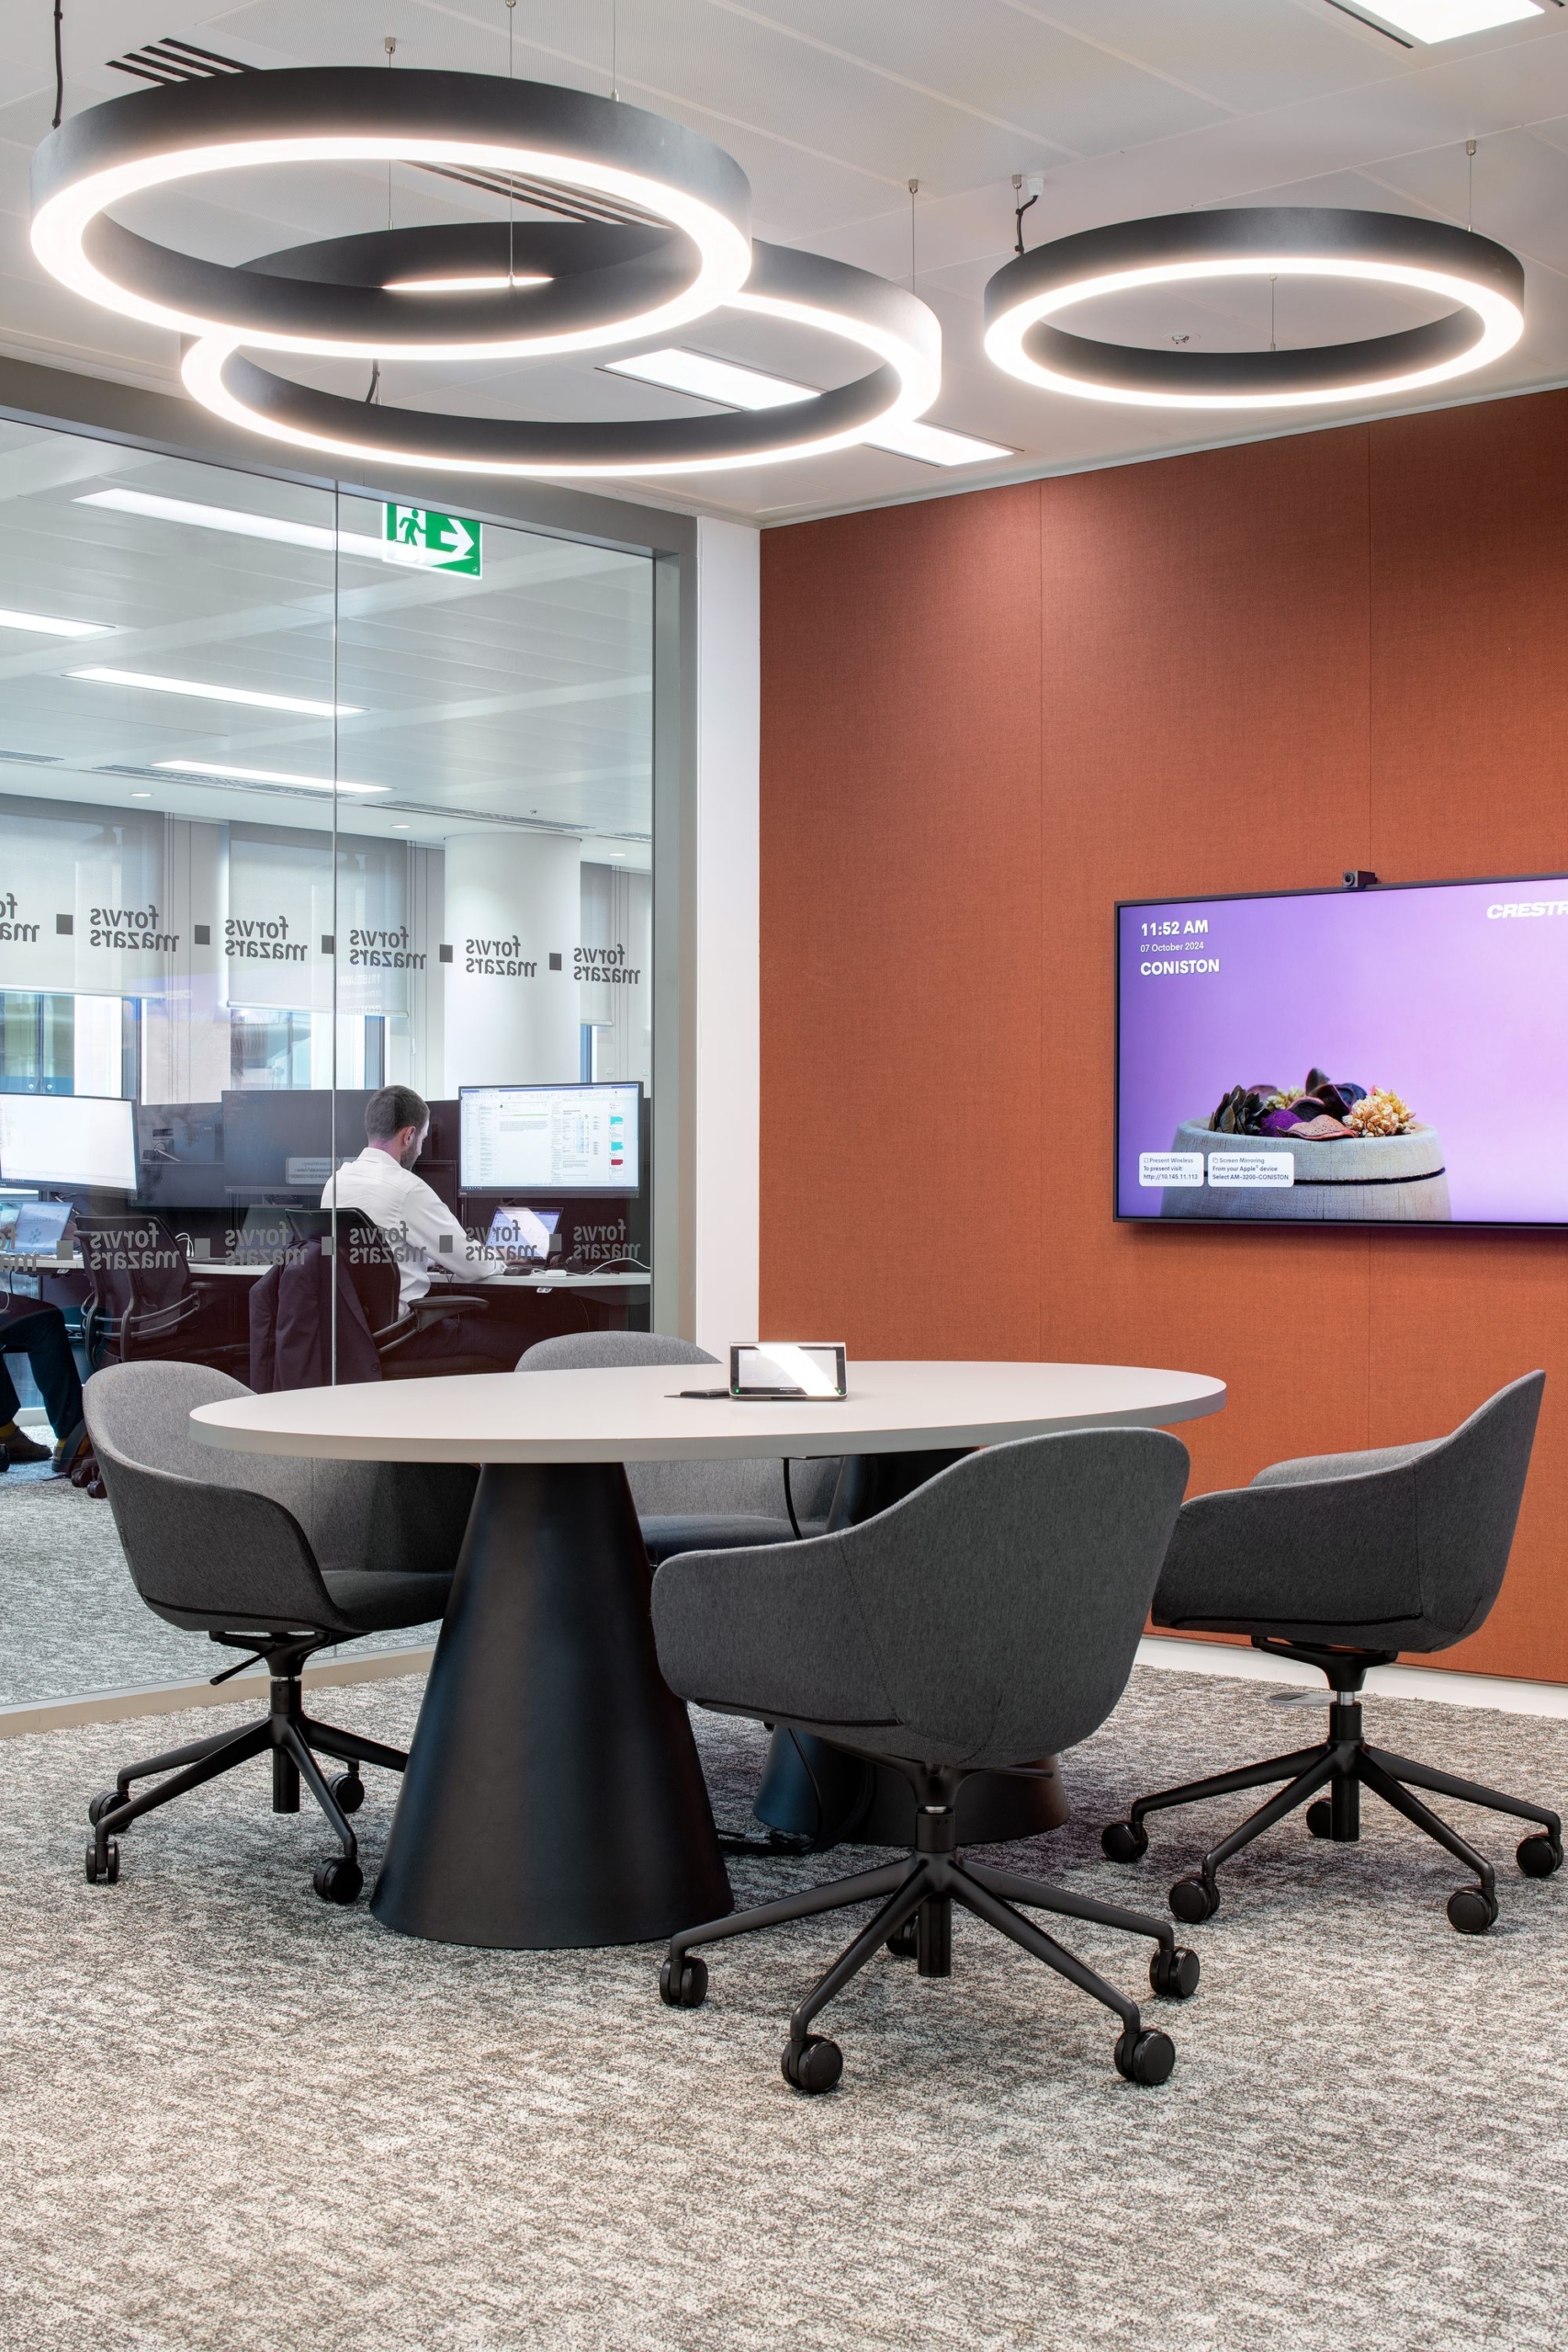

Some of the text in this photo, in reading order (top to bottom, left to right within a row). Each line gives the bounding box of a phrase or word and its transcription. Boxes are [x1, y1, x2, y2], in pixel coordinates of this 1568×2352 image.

[1141, 919, 1209, 936] 11:52 AM
[1140, 941, 1204, 953] 07 October 2024
[1140, 958, 1220, 976] CONISTON
